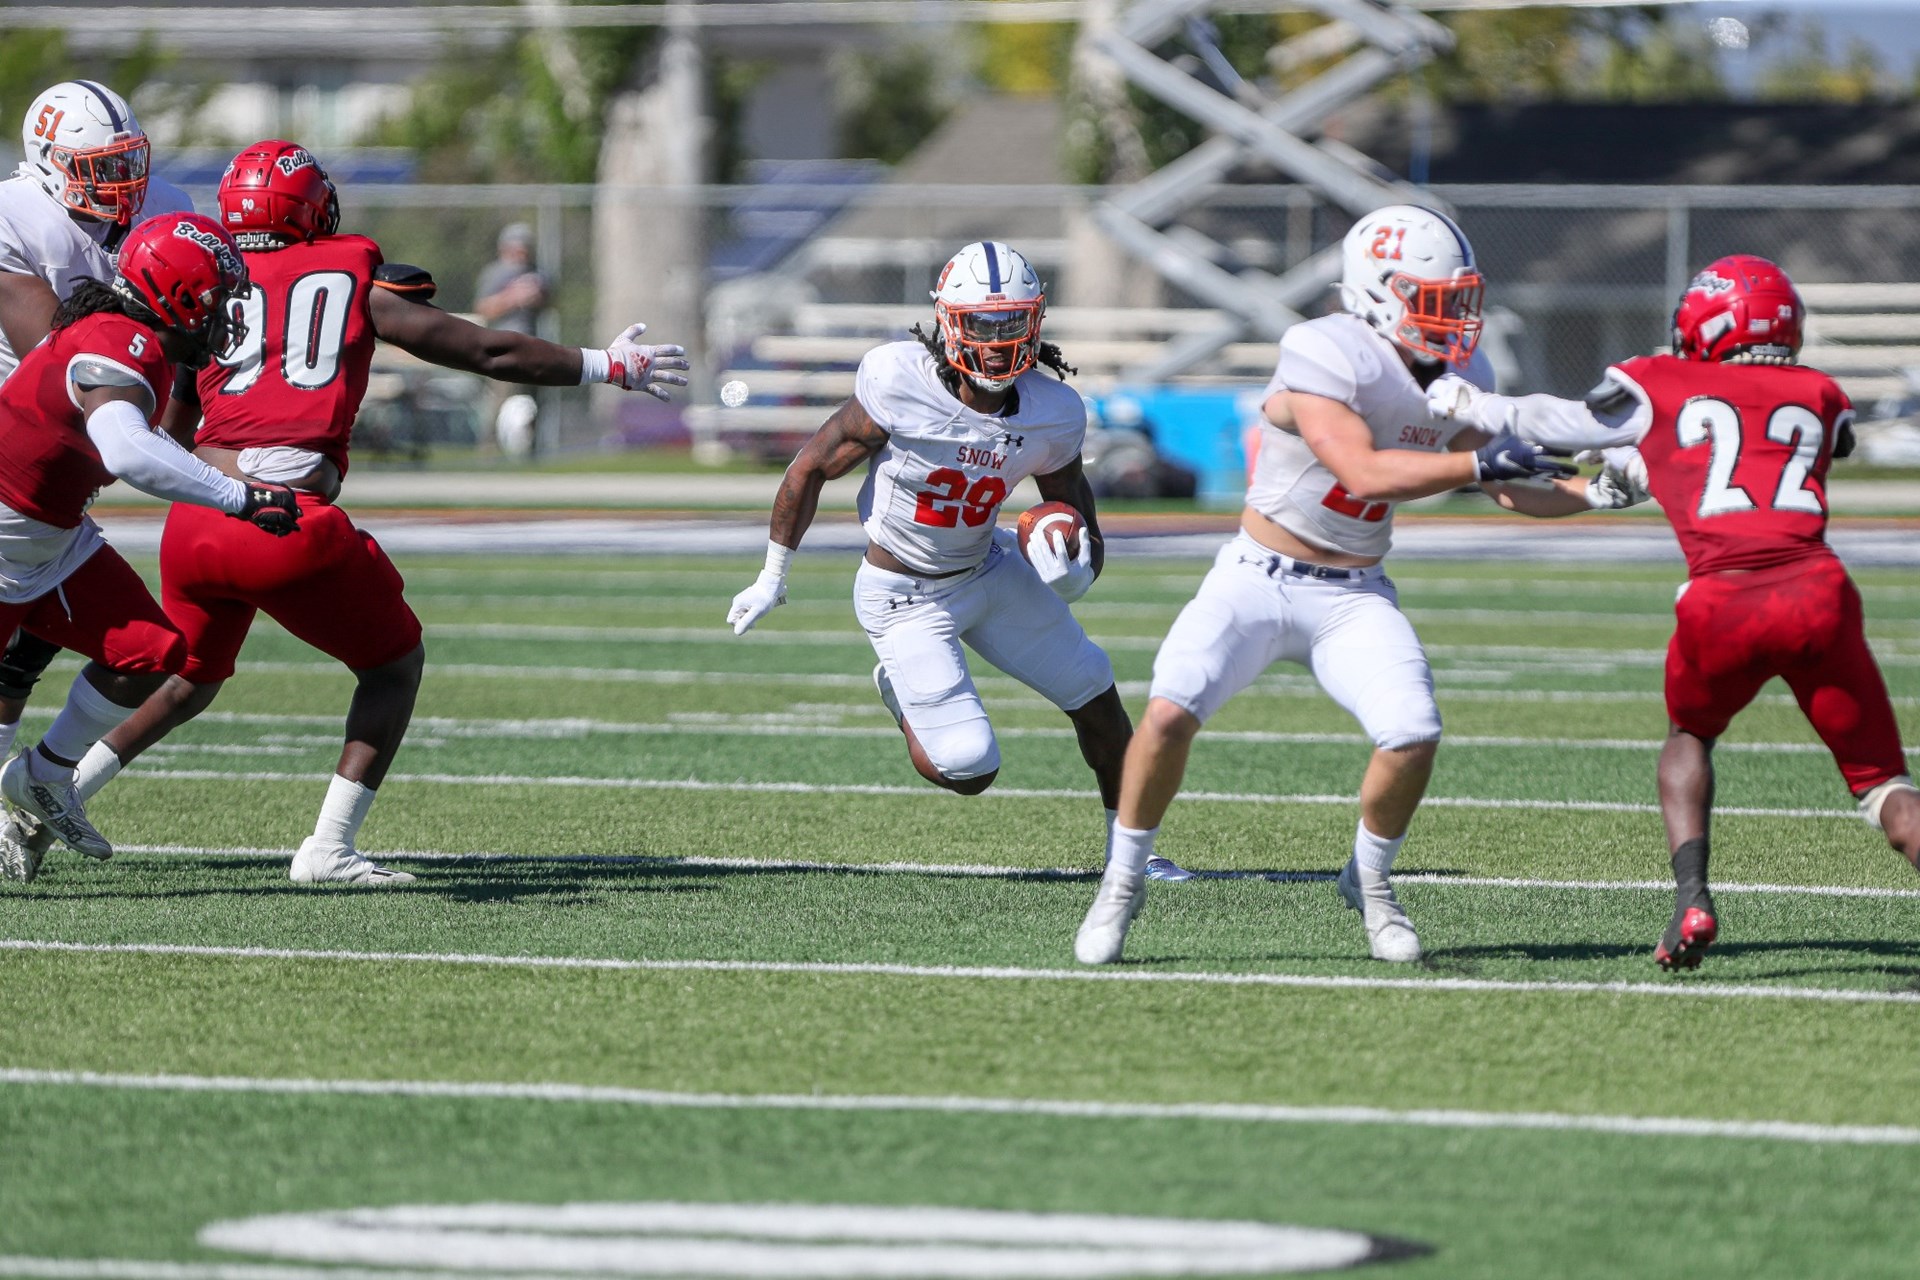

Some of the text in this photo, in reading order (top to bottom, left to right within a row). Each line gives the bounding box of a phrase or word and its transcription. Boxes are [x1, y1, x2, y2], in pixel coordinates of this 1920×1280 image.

[34, 104, 65, 142] 51
[241, 198, 255, 211] 90
[173, 221, 243, 274] Bulldogs
[235, 231, 271, 243] schutt
[1371, 226, 1407, 261] 21
[128, 332, 147, 358] 5
[214, 270, 357, 396] 90
[1398, 424, 1443, 448] SNOW
[955, 445, 1007, 470] SNOW
[1676, 395, 1829, 519] 22
[913, 467, 1007, 529] 29
